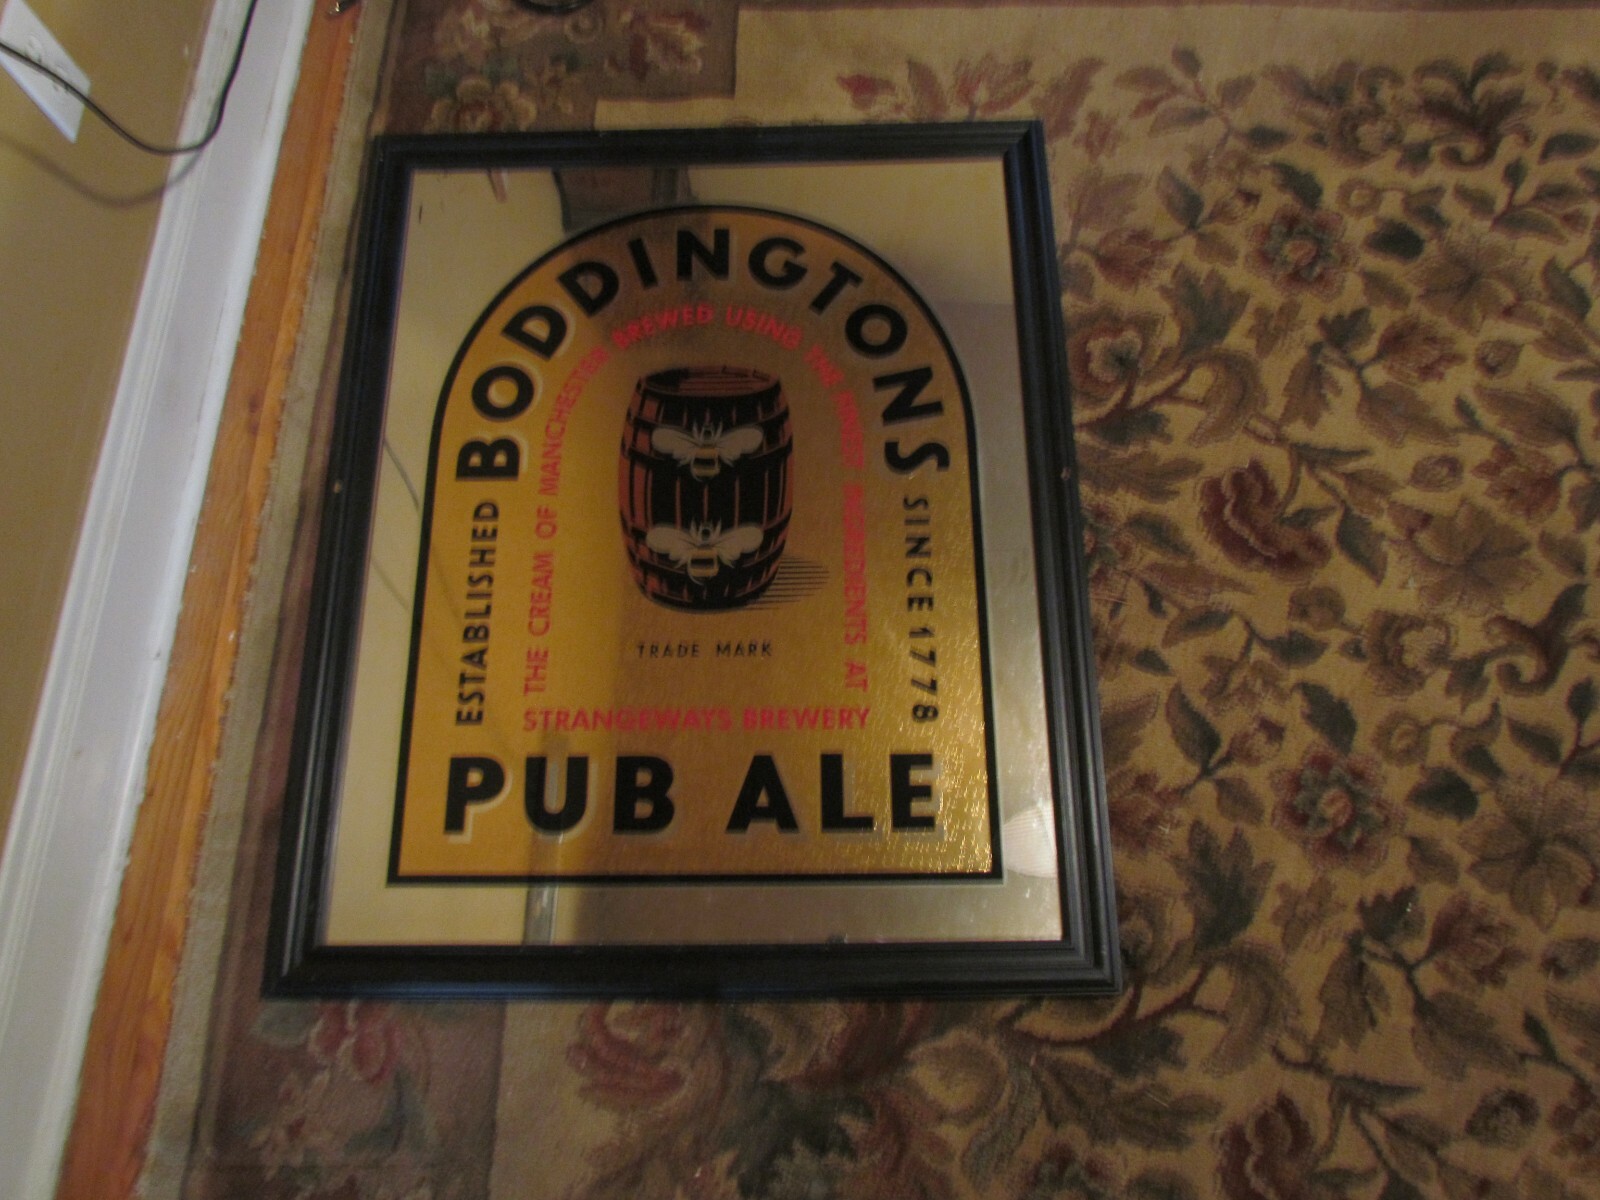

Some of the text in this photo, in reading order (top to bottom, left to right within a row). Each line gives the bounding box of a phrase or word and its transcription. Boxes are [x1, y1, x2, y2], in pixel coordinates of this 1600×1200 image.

[611, 304, 714, 350] BREWED
[724, 306, 803, 350] USING
[456, 228, 950, 481] BODDINGTONS
[538, 345, 611, 496] MANCHESTER
[535, 505, 557, 540] OF
[455, 501, 499, 726] ESTABLISHED
[527, 551, 555, 637] CREAM
[903, 496, 940, 723] SINCE 1778
[523, 646, 549, 696] THE
[637, 637, 773, 659] TRADE MARK
[844, 659, 870, 692] AT
[523, 705, 871, 732] STRANGEWAYS BREWERY
[443, 752, 938, 836] PUB ALE
